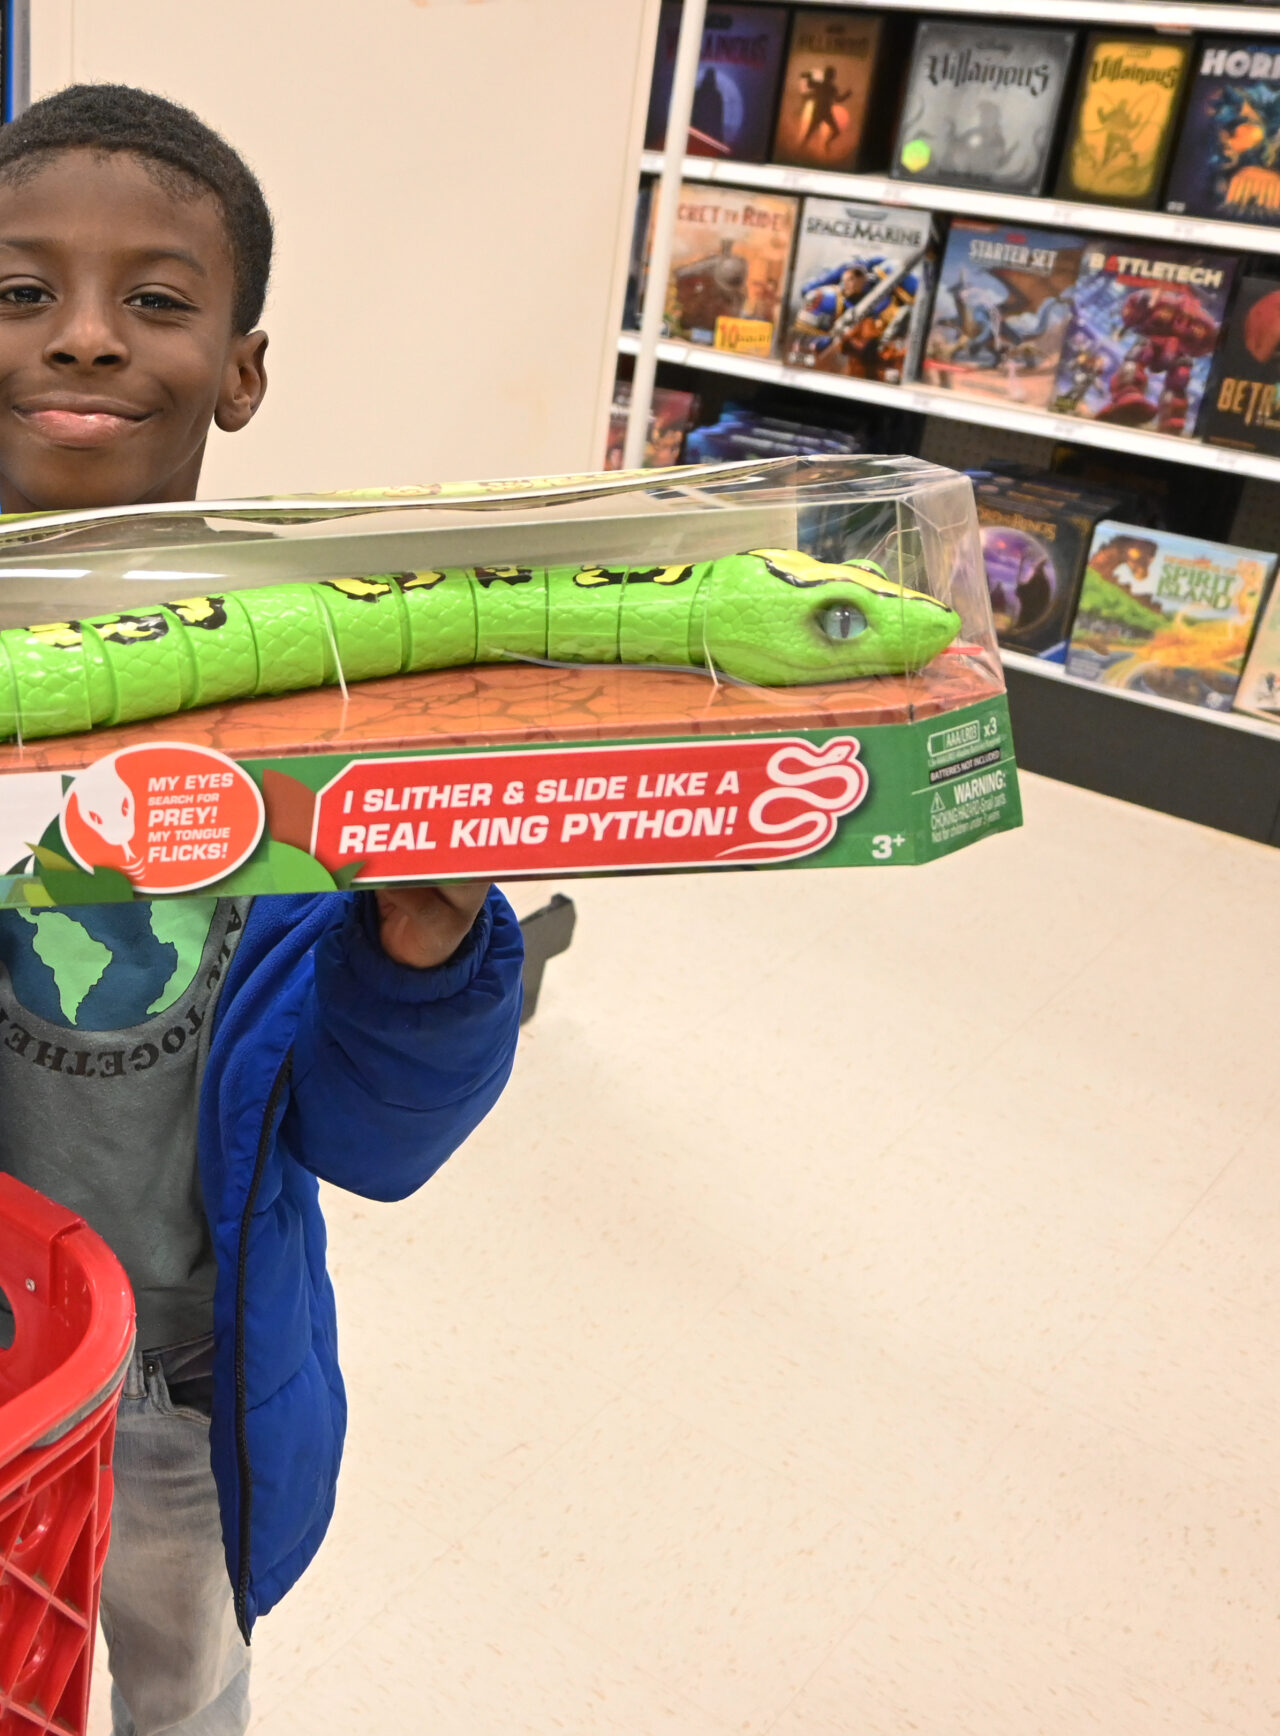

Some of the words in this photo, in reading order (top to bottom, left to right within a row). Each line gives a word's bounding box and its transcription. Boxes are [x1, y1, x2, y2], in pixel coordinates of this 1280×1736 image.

[927, 53, 1050, 96] Villainous
[1090, 56, 1180, 89] Villainous
[968, 239, 1030, 264] STARTER
[1031, 247, 1058, 269] SET
[1088, 252, 1224, 288] BATTLETECH
[983, 717, 998, 738] x3
[930, 763, 961, 783] BATTERIES
[961, 760, 974, 773] NOT
[974, 750, 1001, 767] INCLUDED
[148, 776, 180, 793] MY
[185, 772, 234, 790] EYES
[343, 790, 354, 814] I
[362, 782, 494, 813] SLITHER
[502, 780, 525, 805] &
[535, 775, 628, 803] SLIDE
[635, 771, 709, 799] LIKE
[715, 770, 740, 795] A
[953, 770, 1007, 805] WARNING:
[148, 794, 194, 806] SEARCH
[197, 792, 220, 804] FOR
[148, 806, 218, 828] PREY!
[338, 823, 437, 854] REAL
[449, 814, 550, 849] KING
[560, 806, 738, 843] PYTHON!
[148, 830, 172, 843] MY
[175, 827, 231, 841] TONGUE
[147, 842, 229, 864] FLICKS!
